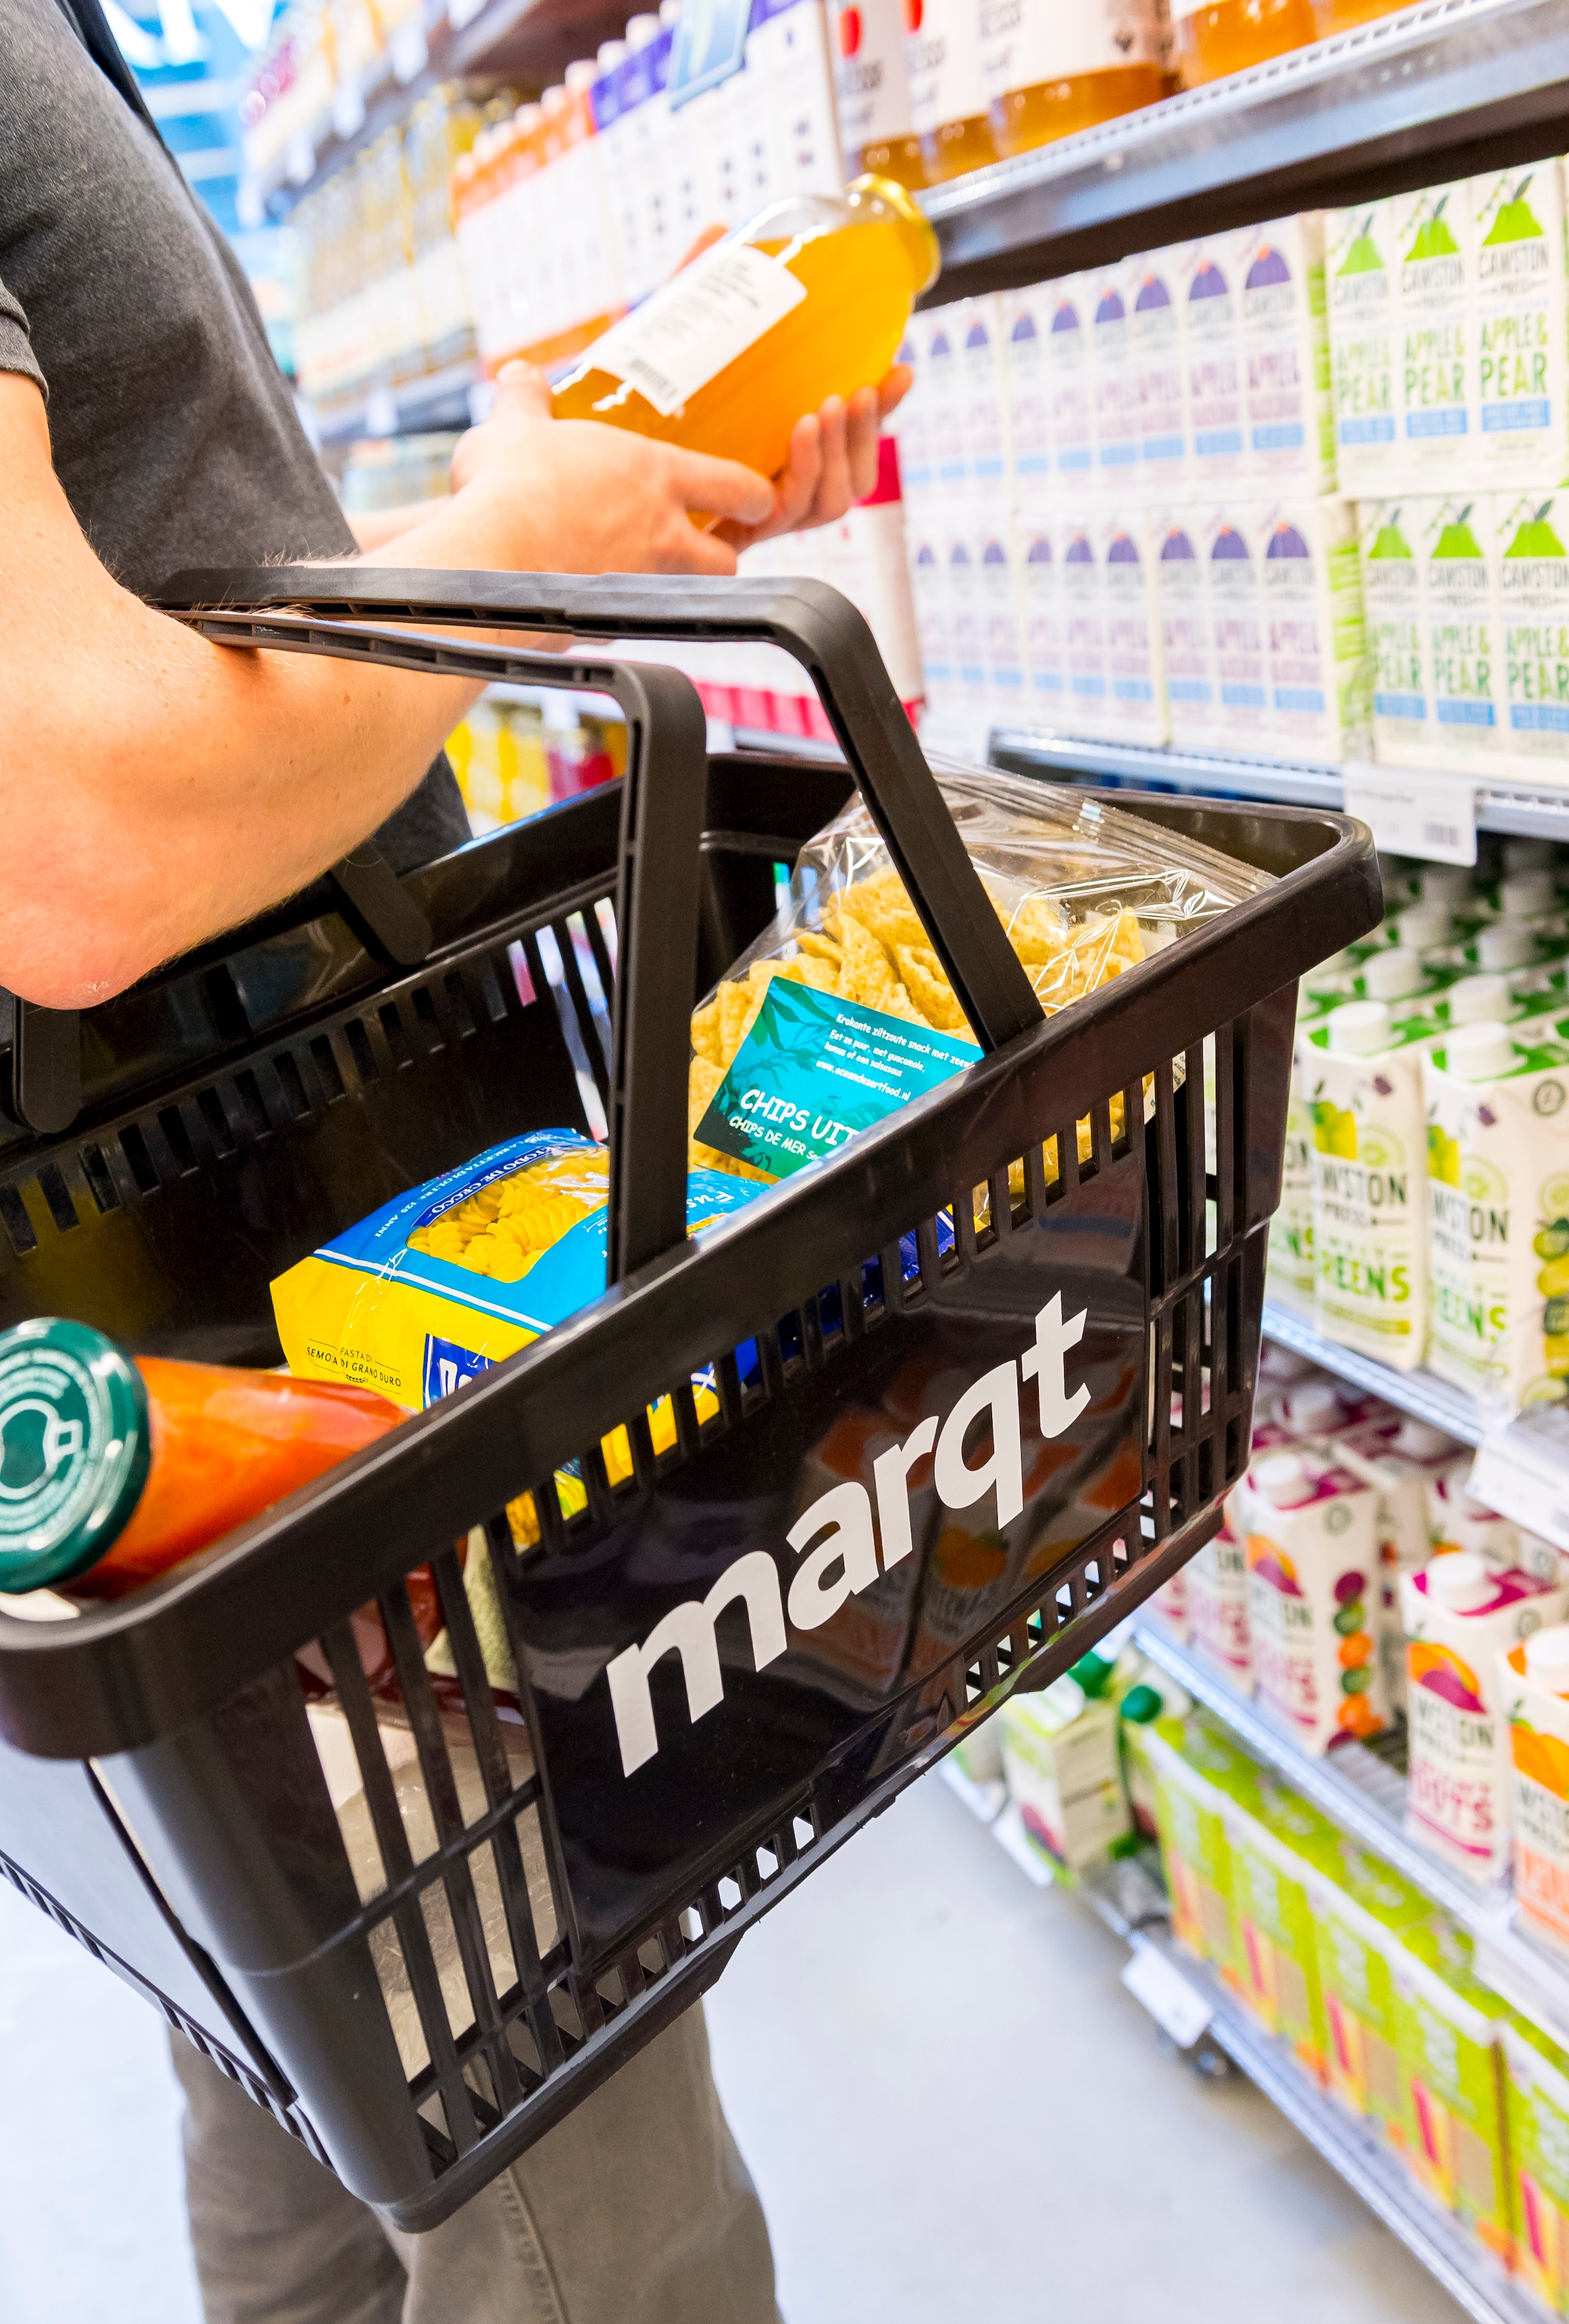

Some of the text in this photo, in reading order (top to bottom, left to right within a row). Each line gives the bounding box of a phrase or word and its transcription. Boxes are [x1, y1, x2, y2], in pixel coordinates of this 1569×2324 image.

[1405, 363, 1465, 406] PEAR
[1480, 352, 1547, 398] PEAR
[1434, 656, 1492, 697] PEAR
[1508, 660, 1569, 703] PEAR
[829, 1029, 844, 1041] Eet
[843, 1035, 853, 1045] ze
[872, 1047, 888, 1057] met
[887, 1052, 926, 1072] guacamole,
[836, 1013, 872, 1033] Krokante
[872, 1027, 908, 1046] ziltzoute
[907, 1040, 933, 1055] snack
[931, 1048, 950, 1061] met
[824, 1041, 903, 1078] humus of een salsasaus
[729, 1115, 766, 1138] CHIPS
[764, 1129, 783, 1146] DE
[780, 1137, 807, 1156] MER
[740, 1089, 860, 1146] CHIPS UIT
[480, 1170, 505, 1183] DE
[431, 1182, 482, 1214] CECCO
[375, 1214, 400, 1238] ANNI
[340, 1347, 373, 1364] PASTA DI
[340, 1358, 348, 1369] DI
[352, 1362, 378, 1379] GRANO
[380, 1371, 402, 1387] DURO
[606, 1289, 1091, 1779] marqt
